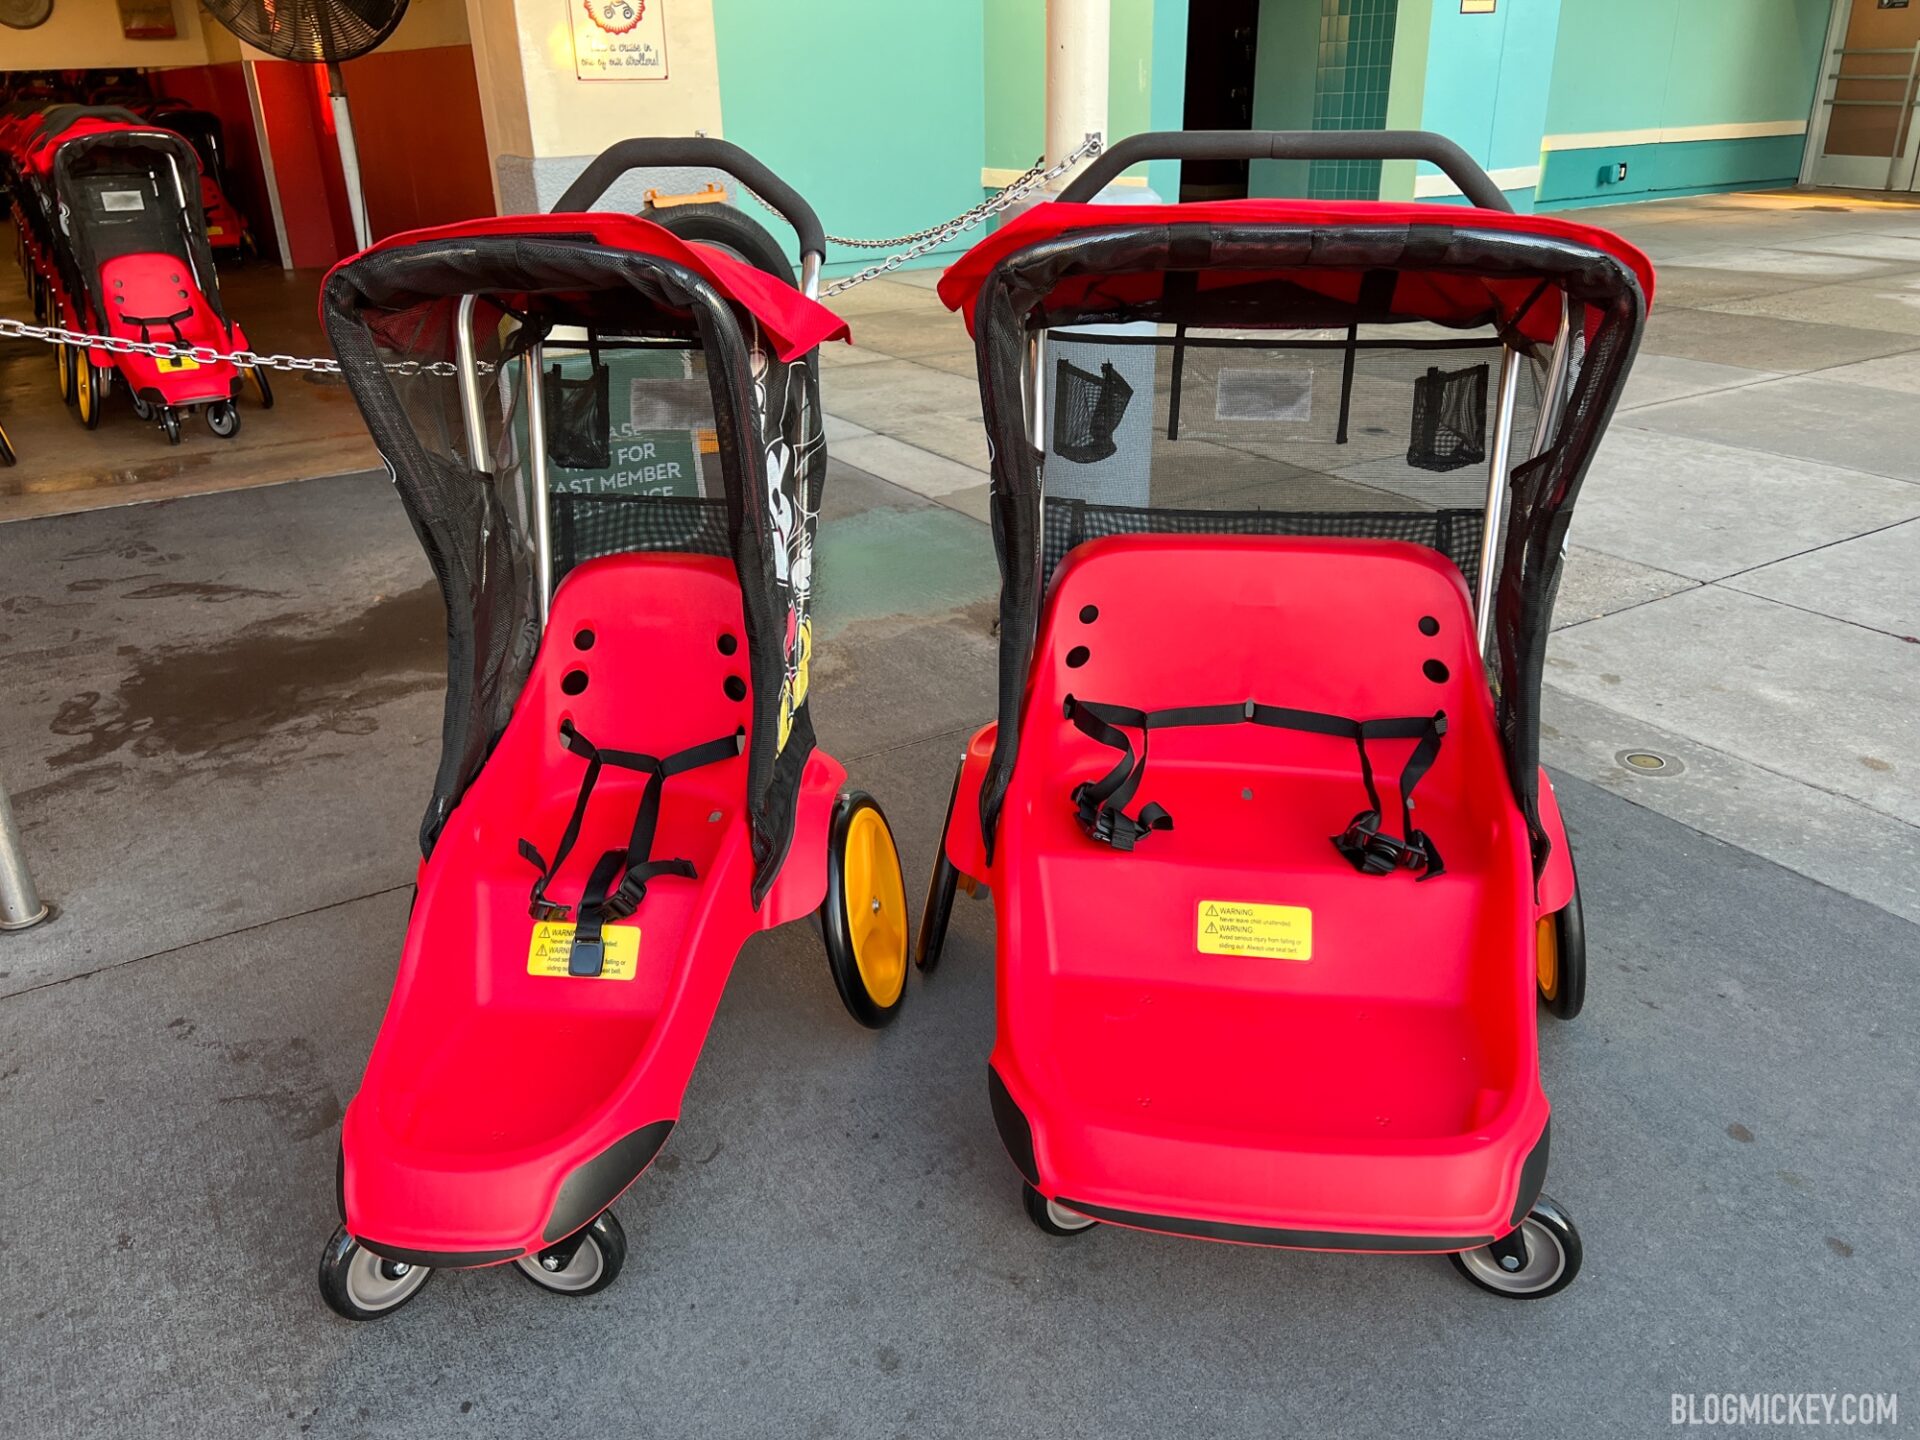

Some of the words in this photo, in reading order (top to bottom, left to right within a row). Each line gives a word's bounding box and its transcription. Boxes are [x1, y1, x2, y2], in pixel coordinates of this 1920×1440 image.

[618, 442, 656, 465] FOR
[548, 477, 594, 494] AST
[600, 462, 682, 492] MEMBER
[1219, 907, 1254, 916] WARNING
[1219, 925, 1254, 934] WARNING
